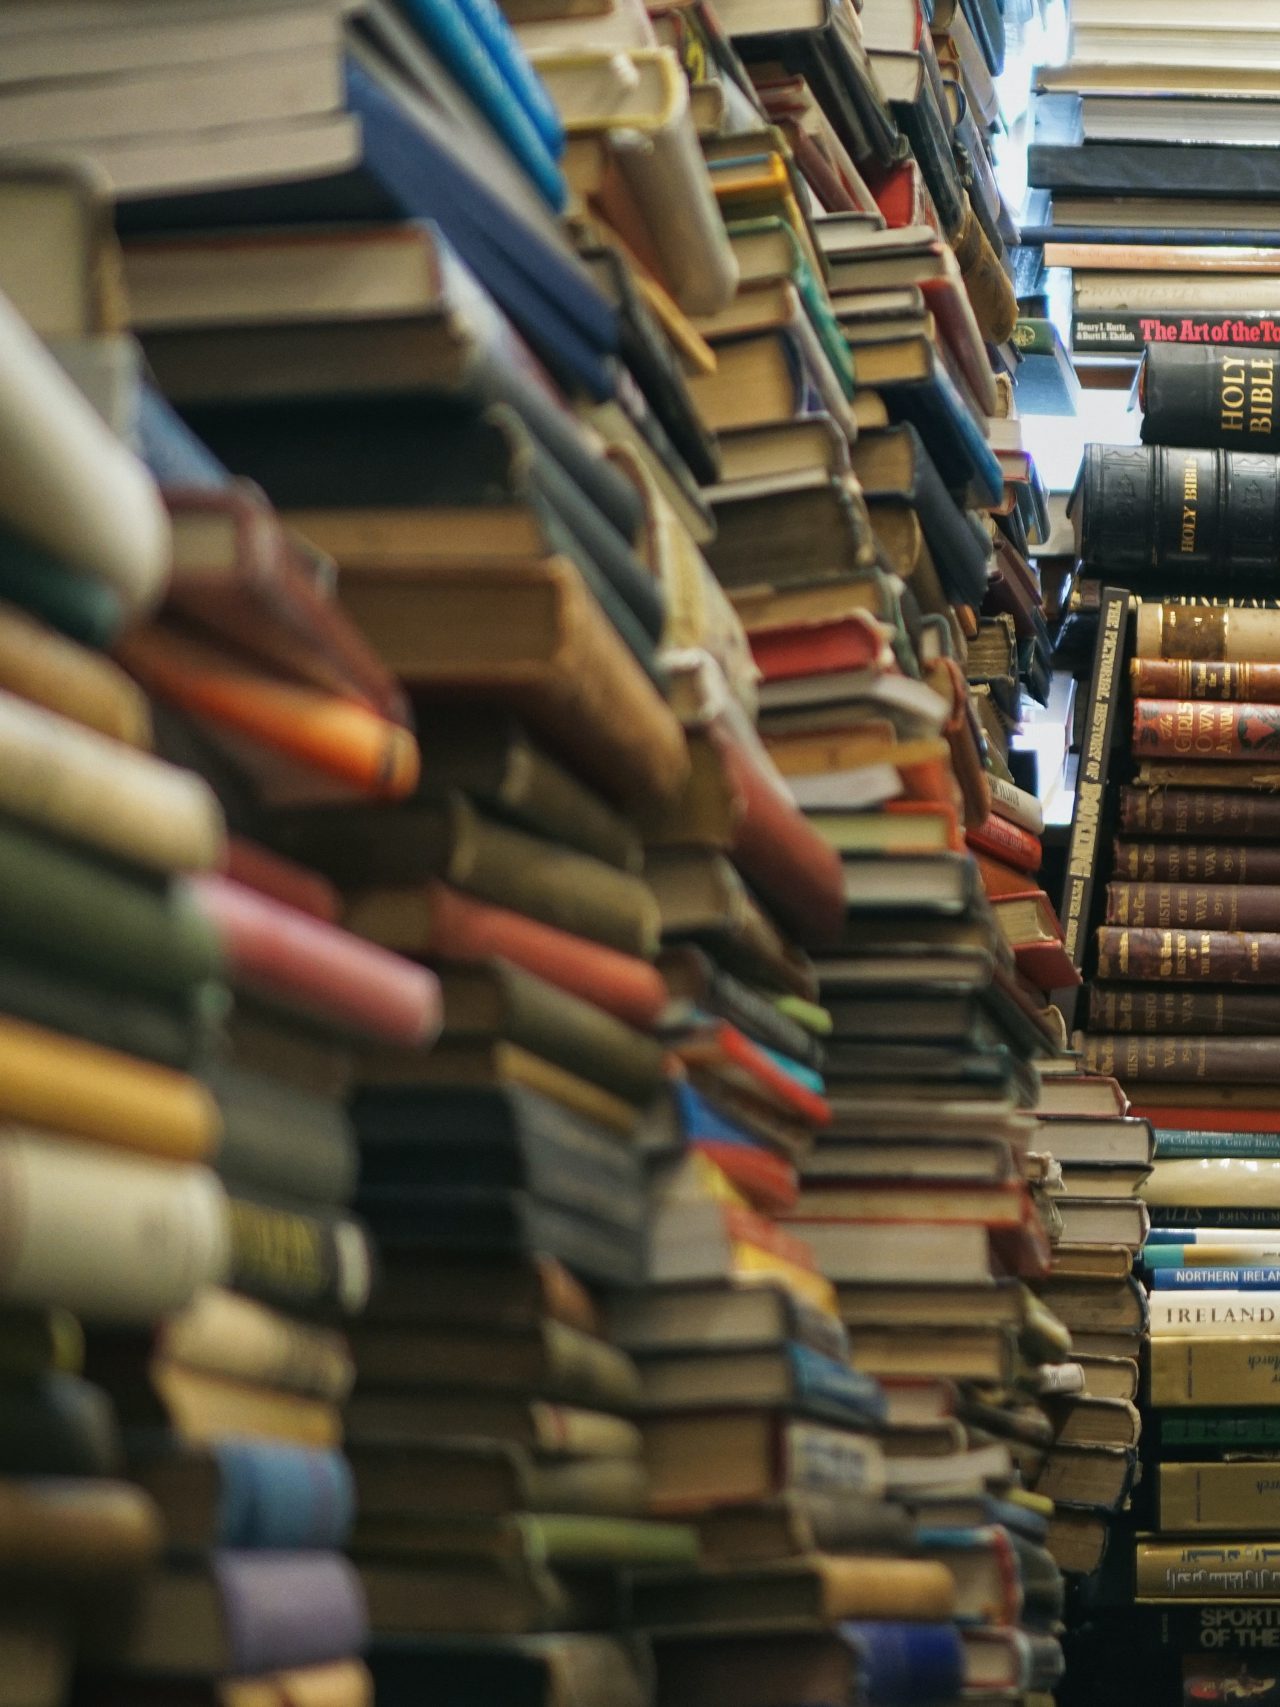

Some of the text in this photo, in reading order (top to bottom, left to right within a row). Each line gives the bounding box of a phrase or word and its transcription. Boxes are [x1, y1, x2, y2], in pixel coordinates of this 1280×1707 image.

[1077, 322, 1096, 332] Henry
[1140, 319, 1177, 342] The
[1180, 319, 1209, 342] Art
[1211, 320, 1230, 342] of
[1231, 320, 1259, 342] the
[1220, 355, 1246, 432] HOLY
[1250, 358, 1274, 434] BIBLE
[1181, 457, 1197, 552] HOLY BIBLE
[1087, 601, 1122, 779] THE PICTORIAL HISTORY OF
[1197, 704, 1215, 752] OWN
[1178, 908, 1187, 921] OF
[1177, 934, 1186, 974] HISTORY
[1225, 1139, 1252, 1148] GREAT
[1216, 1209, 1250, 1223] JOHN
[1175, 1270, 1239, 1283] NORTHERN
[1166, 1307, 1276, 1323] IRELAND
[1200, 1628, 1235, 1648] OF
[1237, 1628, 1280, 1647] THE
